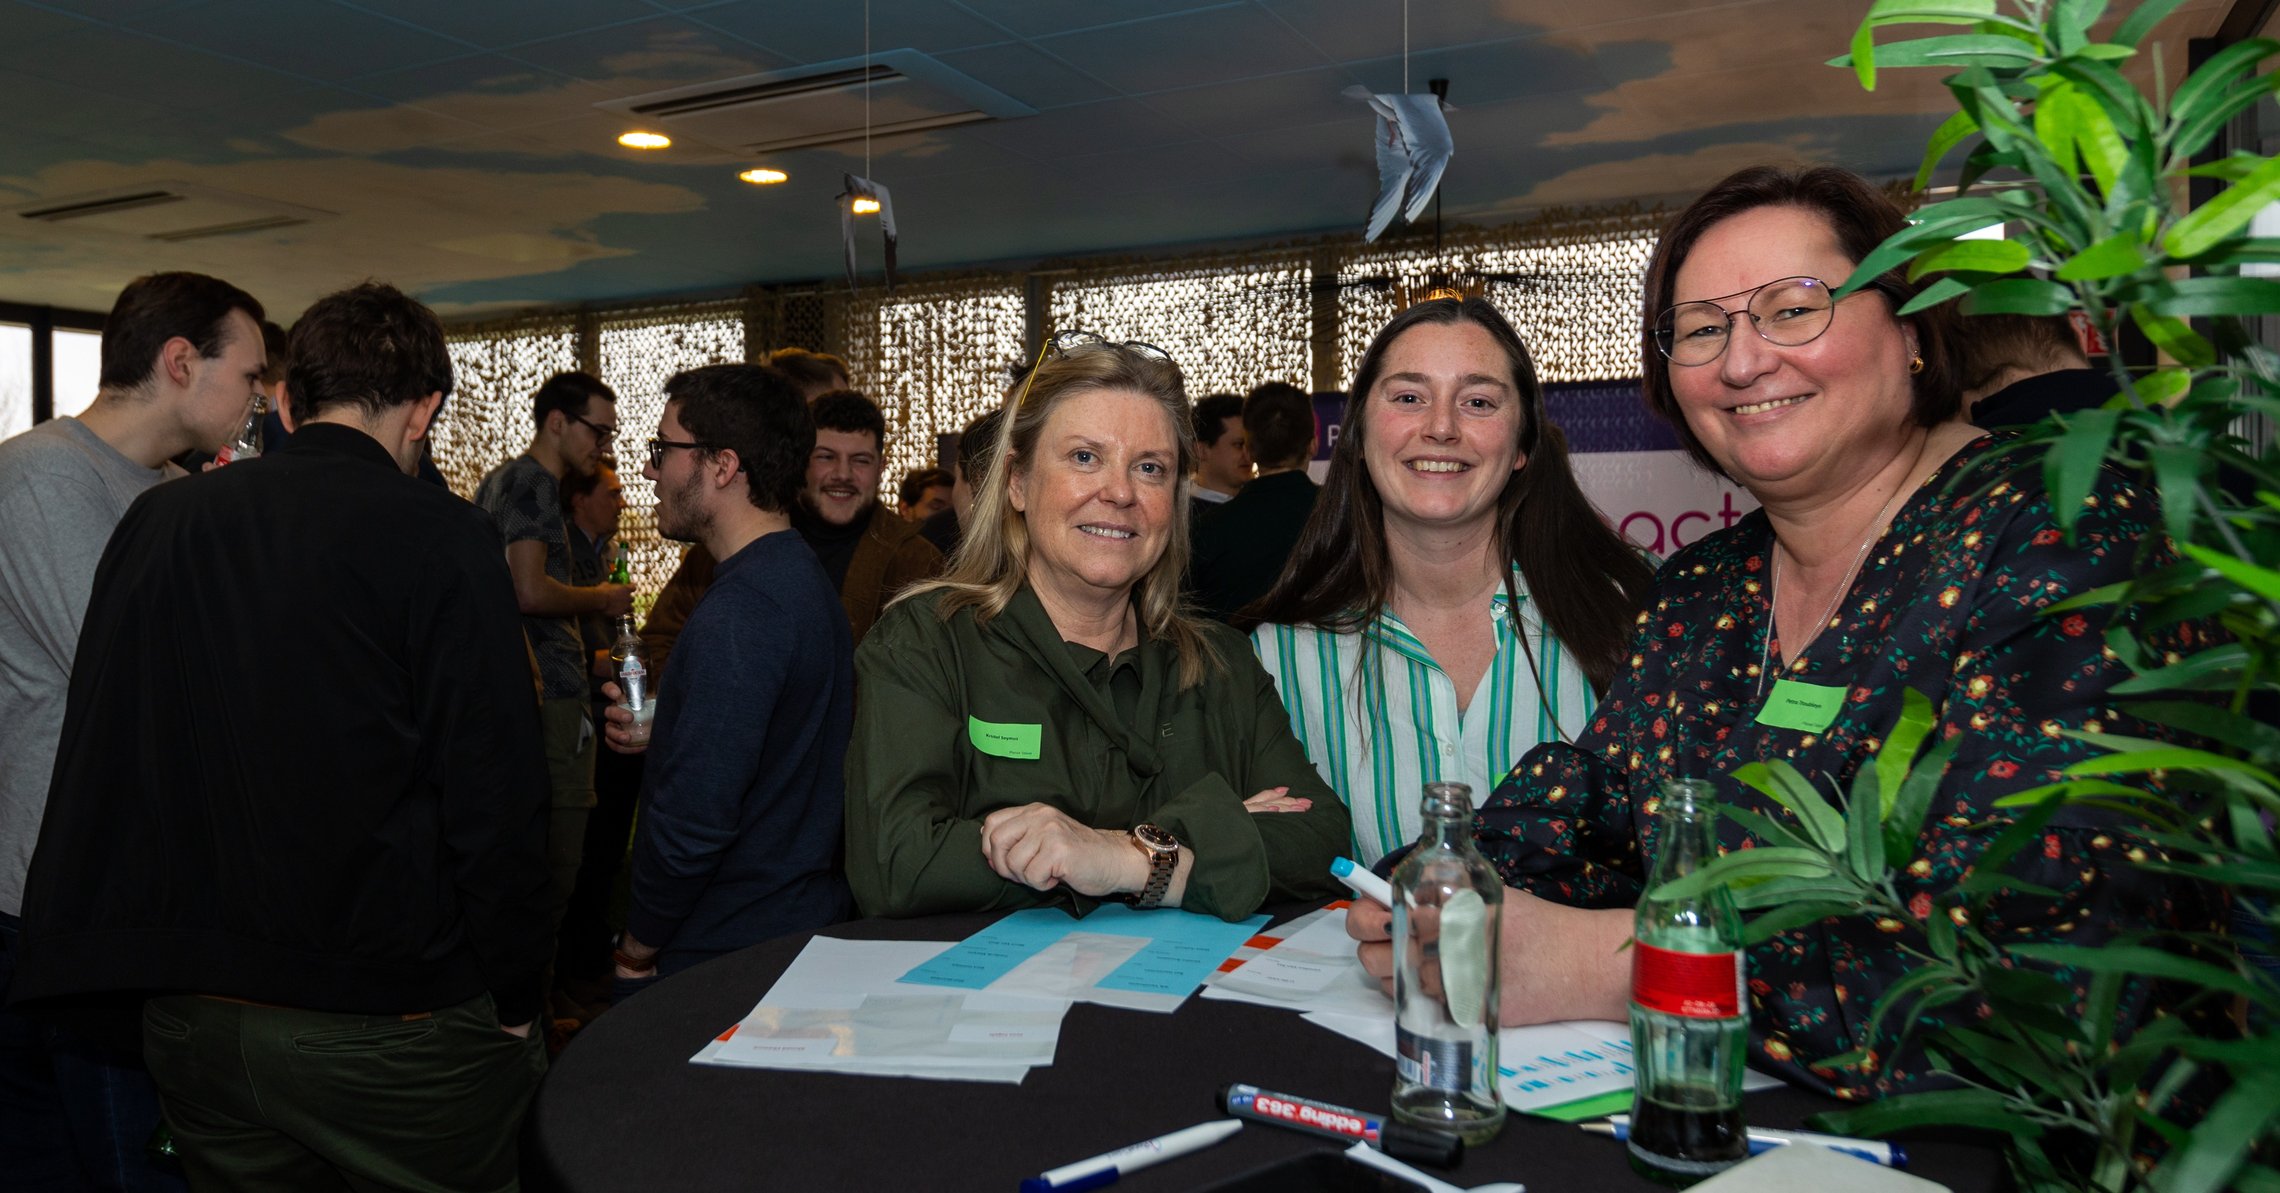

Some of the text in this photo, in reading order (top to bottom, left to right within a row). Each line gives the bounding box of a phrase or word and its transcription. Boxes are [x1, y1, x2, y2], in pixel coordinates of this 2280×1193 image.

[1601, 491, 1742, 555] act
[1255, 1097, 1297, 1118] 363
[1300, 1105, 1362, 1133] edding
